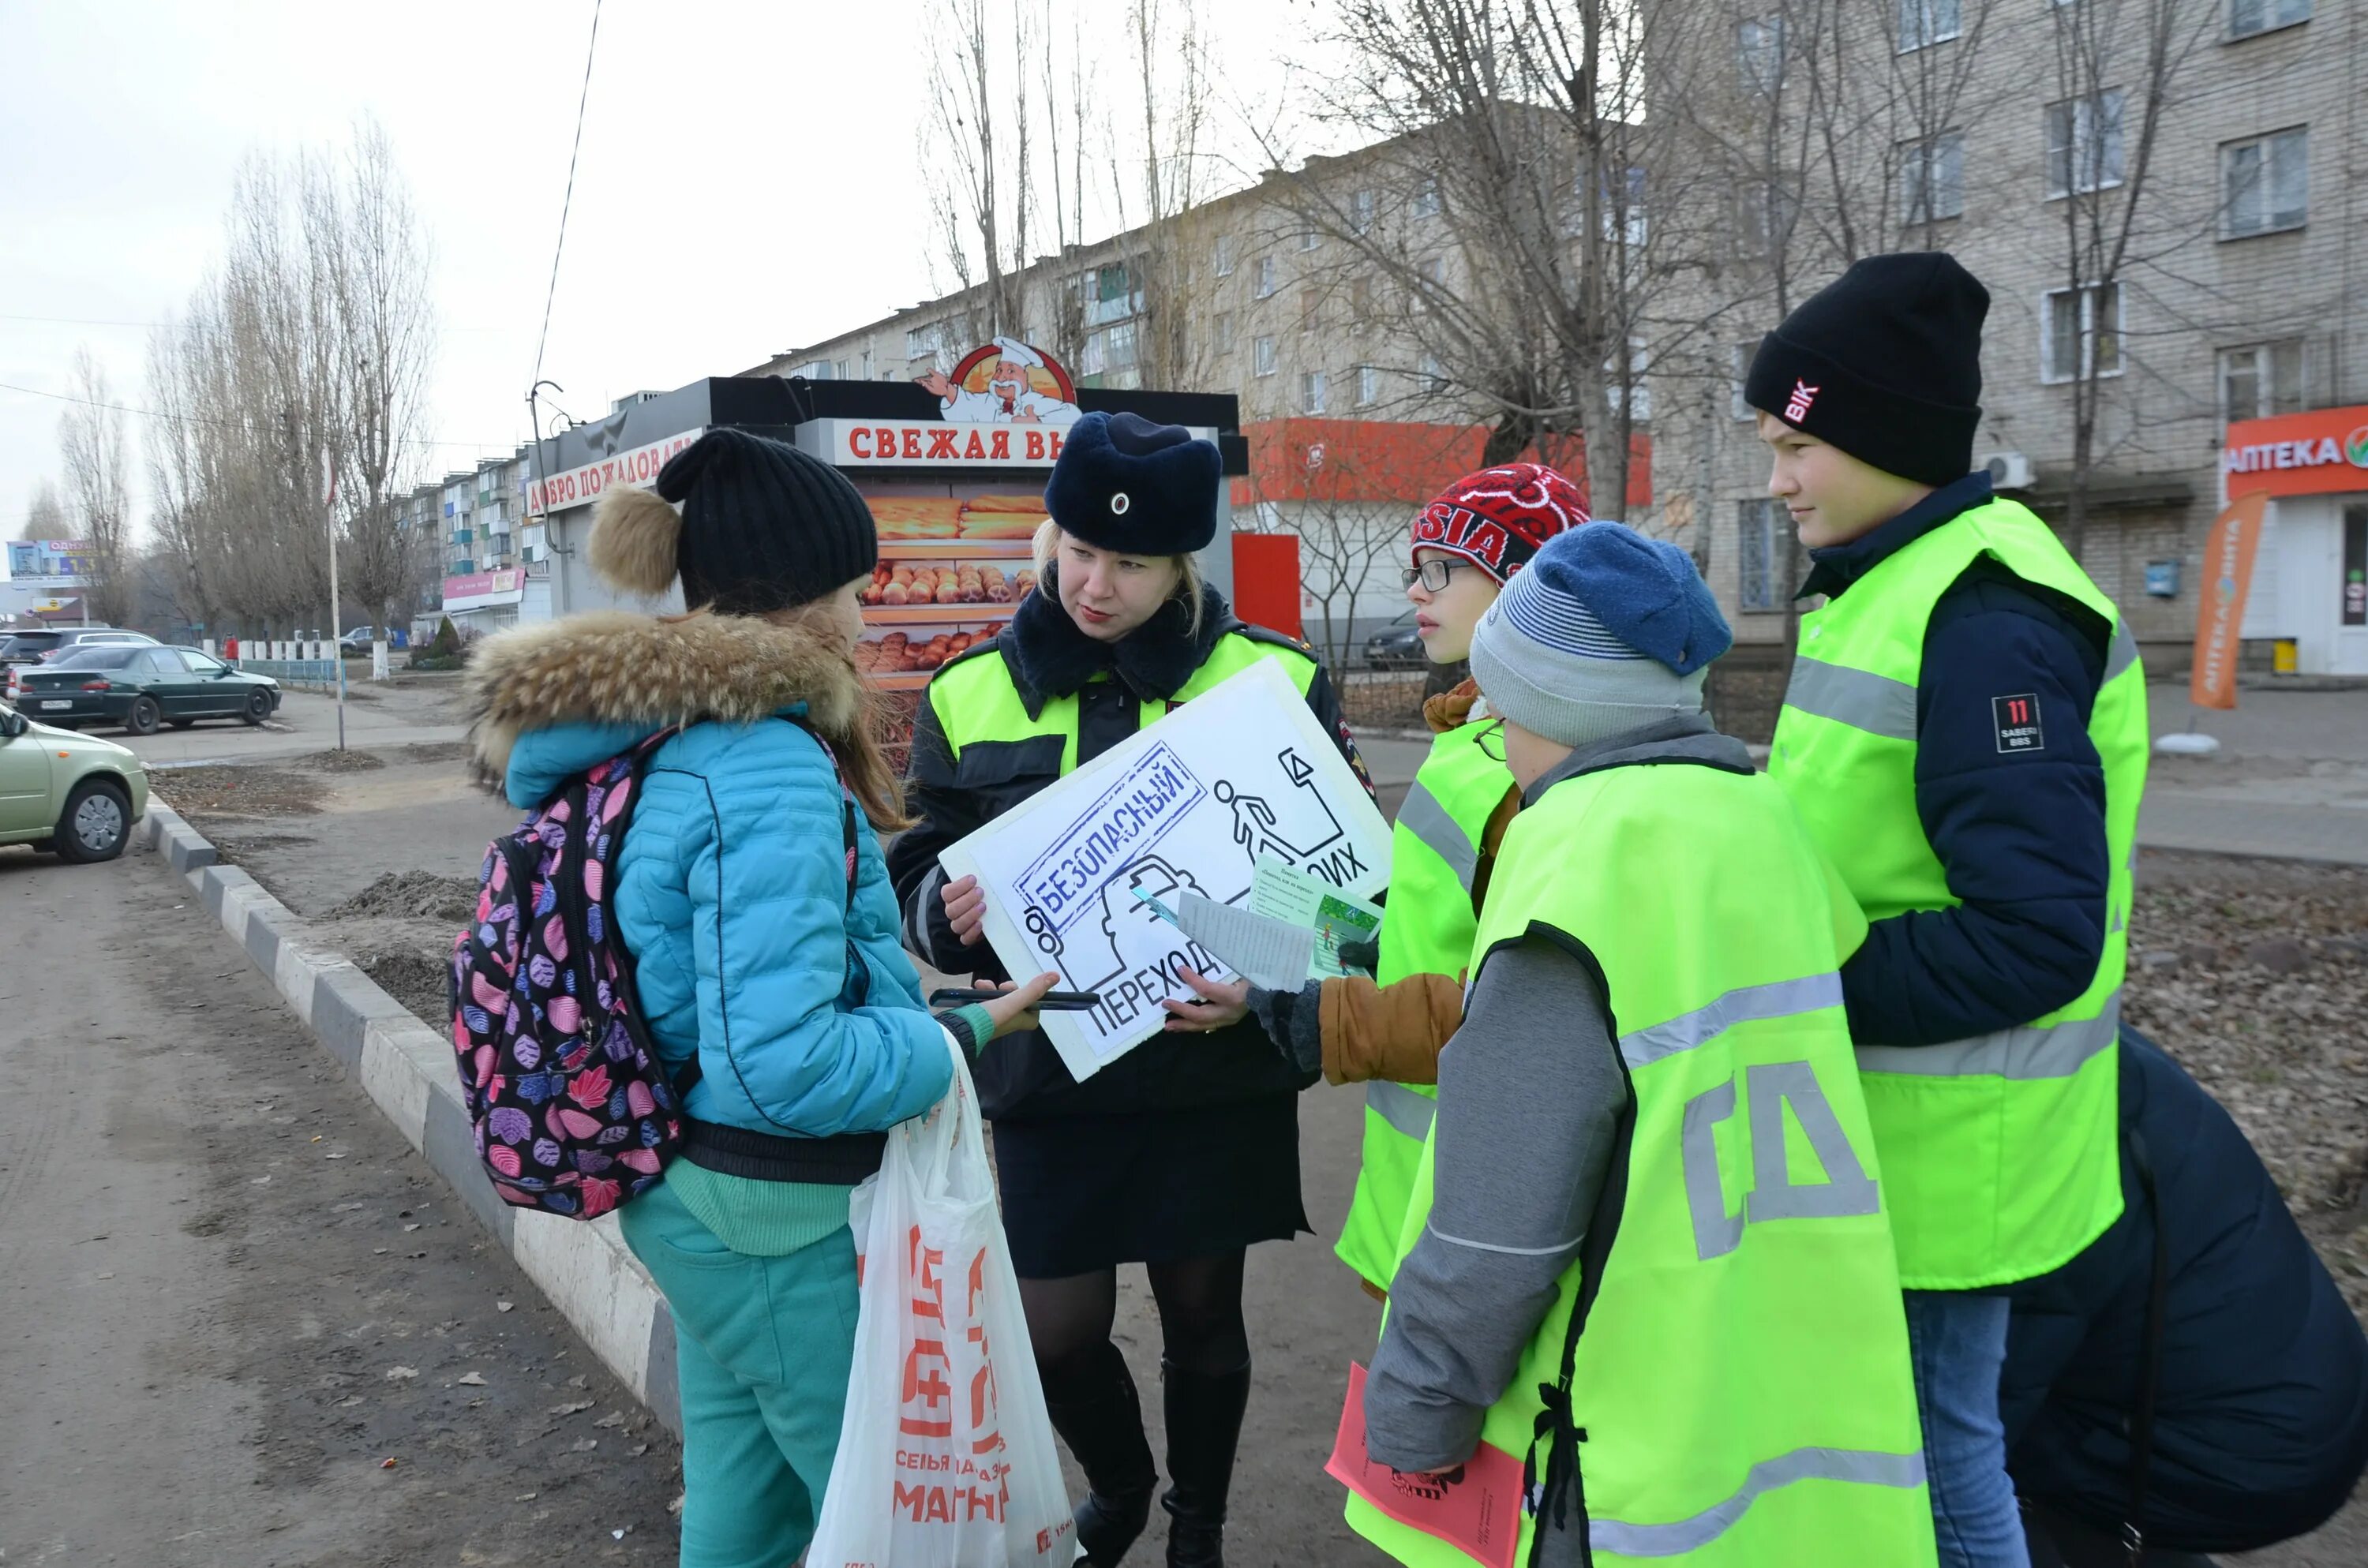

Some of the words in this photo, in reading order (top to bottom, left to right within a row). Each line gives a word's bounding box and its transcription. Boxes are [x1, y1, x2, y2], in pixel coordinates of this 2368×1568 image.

[849, 427, 1010, 459] СВЕЖАЯ
[2225, 436, 2343, 473] АПТЕКА
[531, 475, 575, 514] ДОБРО
[2008, 700, 2029, 724] 11
[1036, 761, 1185, 914] БЕЗОПАСНЫЙ
[1088, 940, 1221, 1037] ПЕРЕХОД
